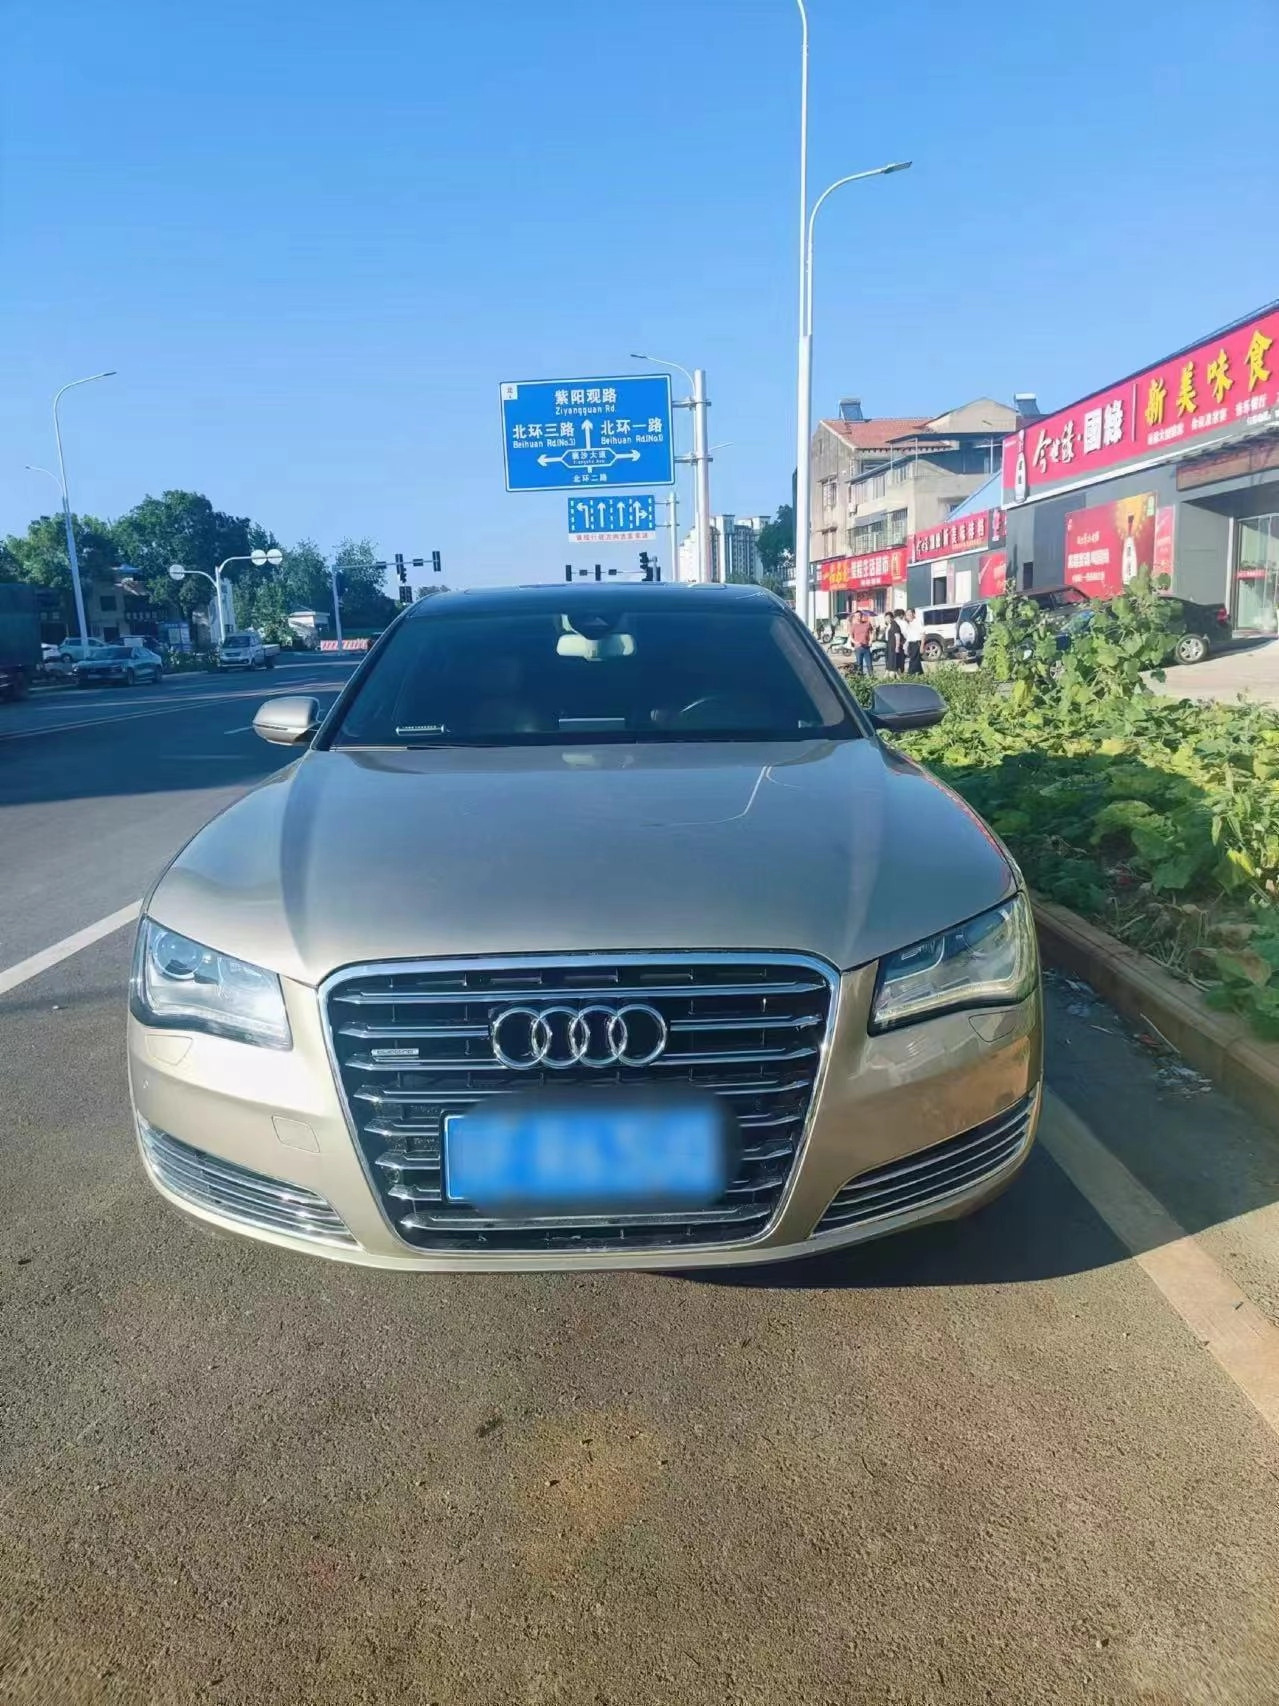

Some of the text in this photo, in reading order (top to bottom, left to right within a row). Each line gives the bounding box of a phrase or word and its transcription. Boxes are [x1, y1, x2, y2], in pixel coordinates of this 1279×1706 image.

[555, 388, 617, 405] 紫阳观路
[555, 406, 603, 416] Ziyangguan
[512, 421, 575, 439] 北环三路
[601, 417, 663, 435] 北环一路
[512, 440, 544, 449] Beihuan
[600, 436, 632, 445] Beihuan
